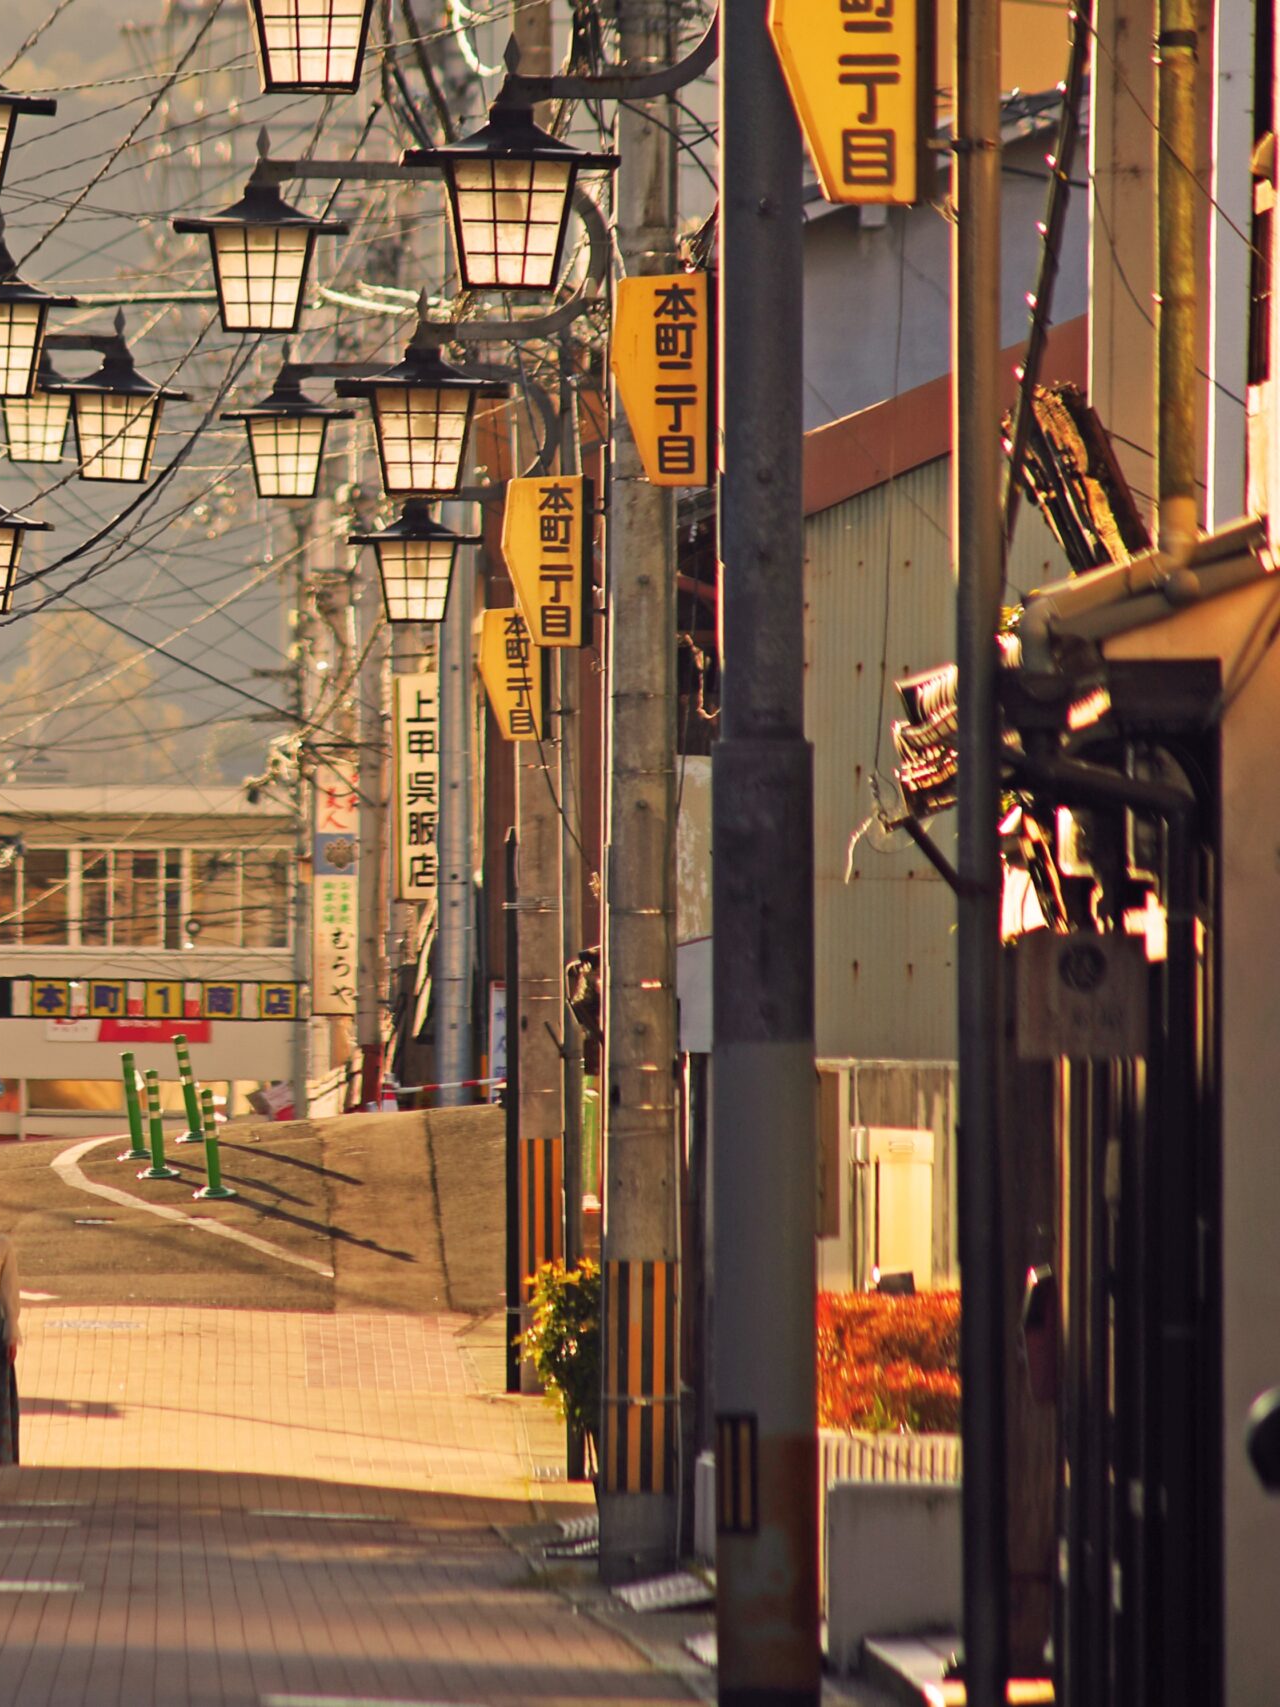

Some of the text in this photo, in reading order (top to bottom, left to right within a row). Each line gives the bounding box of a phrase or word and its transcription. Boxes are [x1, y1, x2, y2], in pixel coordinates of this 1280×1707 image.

[654, 283, 697, 474] 本町二丁目
[539, 483, 574, 637] 本町二丁目
[504, 613, 534, 735] 本町二丁目
